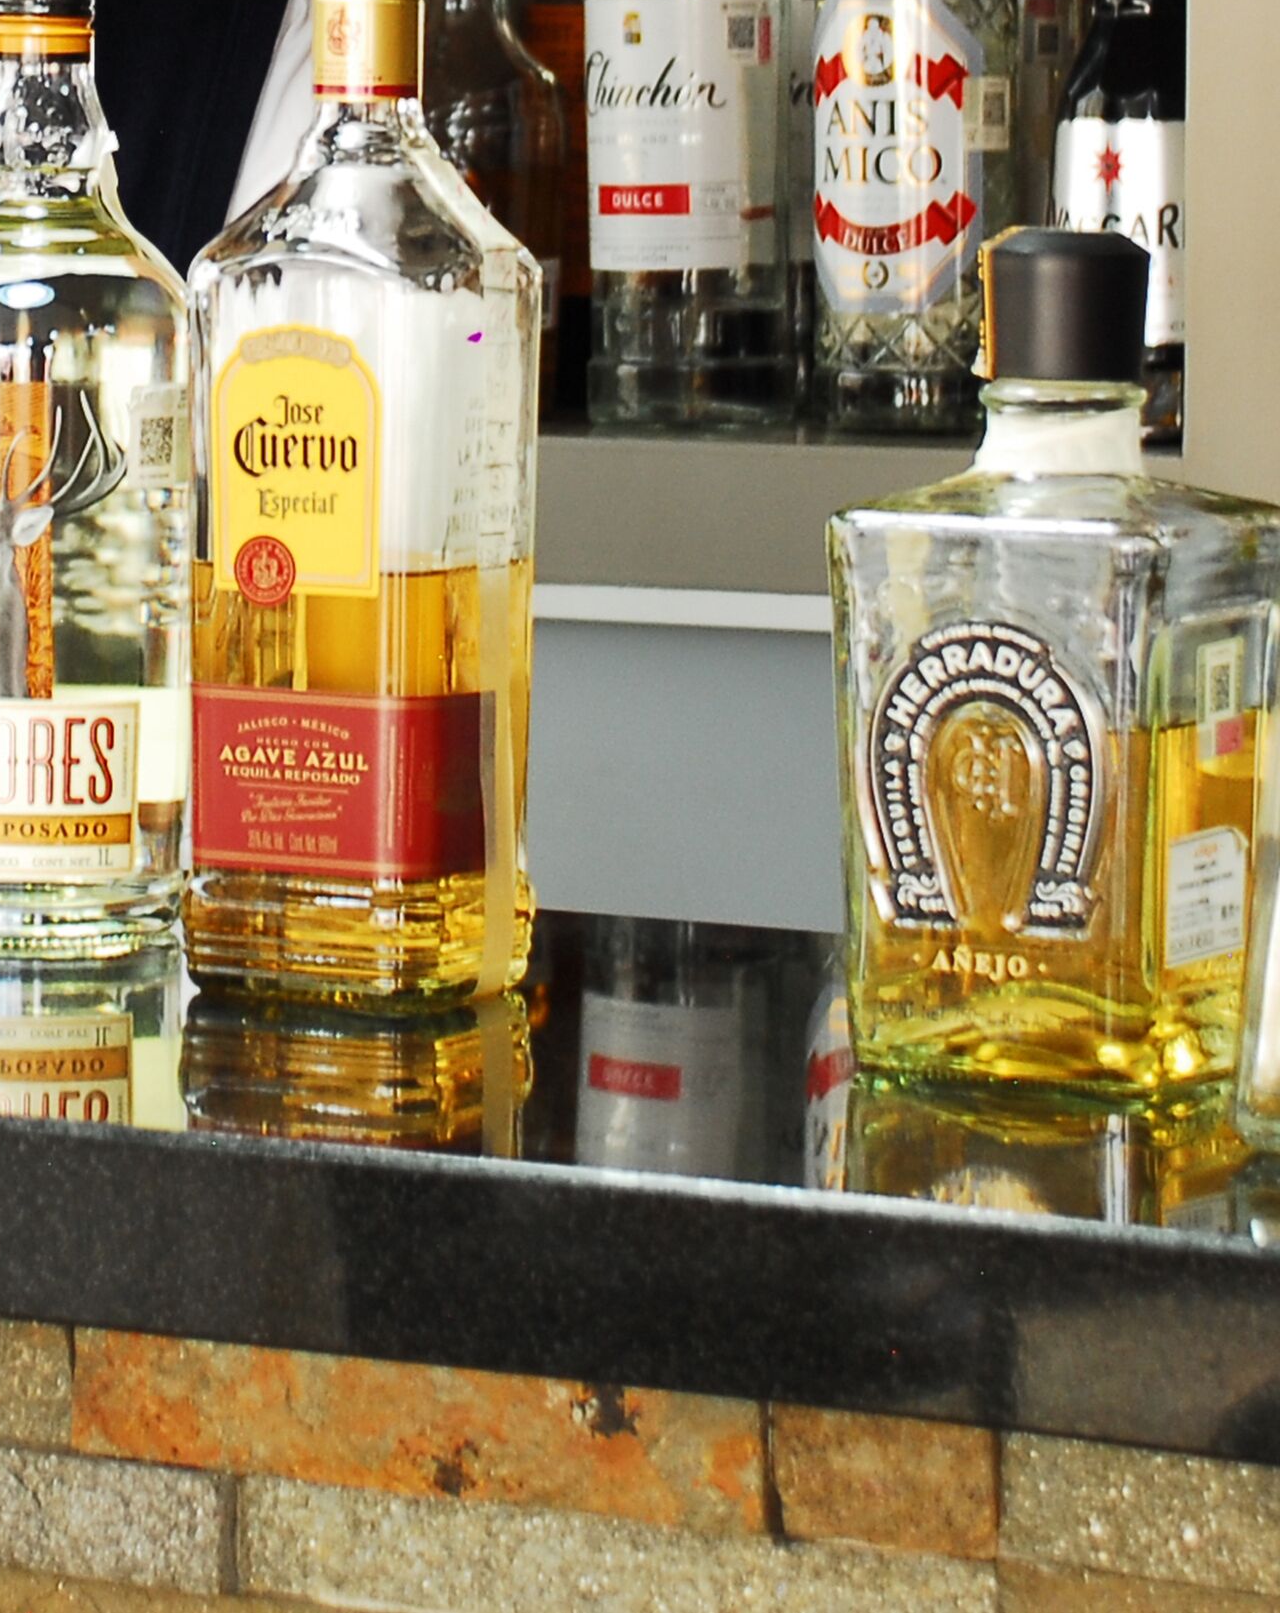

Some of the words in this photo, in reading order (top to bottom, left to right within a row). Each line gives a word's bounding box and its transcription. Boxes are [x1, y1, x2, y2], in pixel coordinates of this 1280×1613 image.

[585, 50, 727, 118] Chinchón
[826, 99, 929, 136] ANIS
[823, 146, 943, 185] MICO
[611, 191, 664, 209] DULCE
[274, 394, 325, 429] Jose
[233, 415, 358, 478] Cuervo
[257, 488, 338, 520] Especial
[886, 641, 1080, 738] HERRADURA
[238, 716, 288, 734] JALISCO
[219, 744, 297, 766] AGAVE
[304, 749, 369, 771] AZUL
[223, 765, 281, 780] TEQUILA
[284, 769, 361, 785] REPOSADO
[883, 758, 918, 869] TEQUILA
[1055, 763, 1089, 875] ORIGINAL
[931, 943, 1029, 983] AÑEJO
